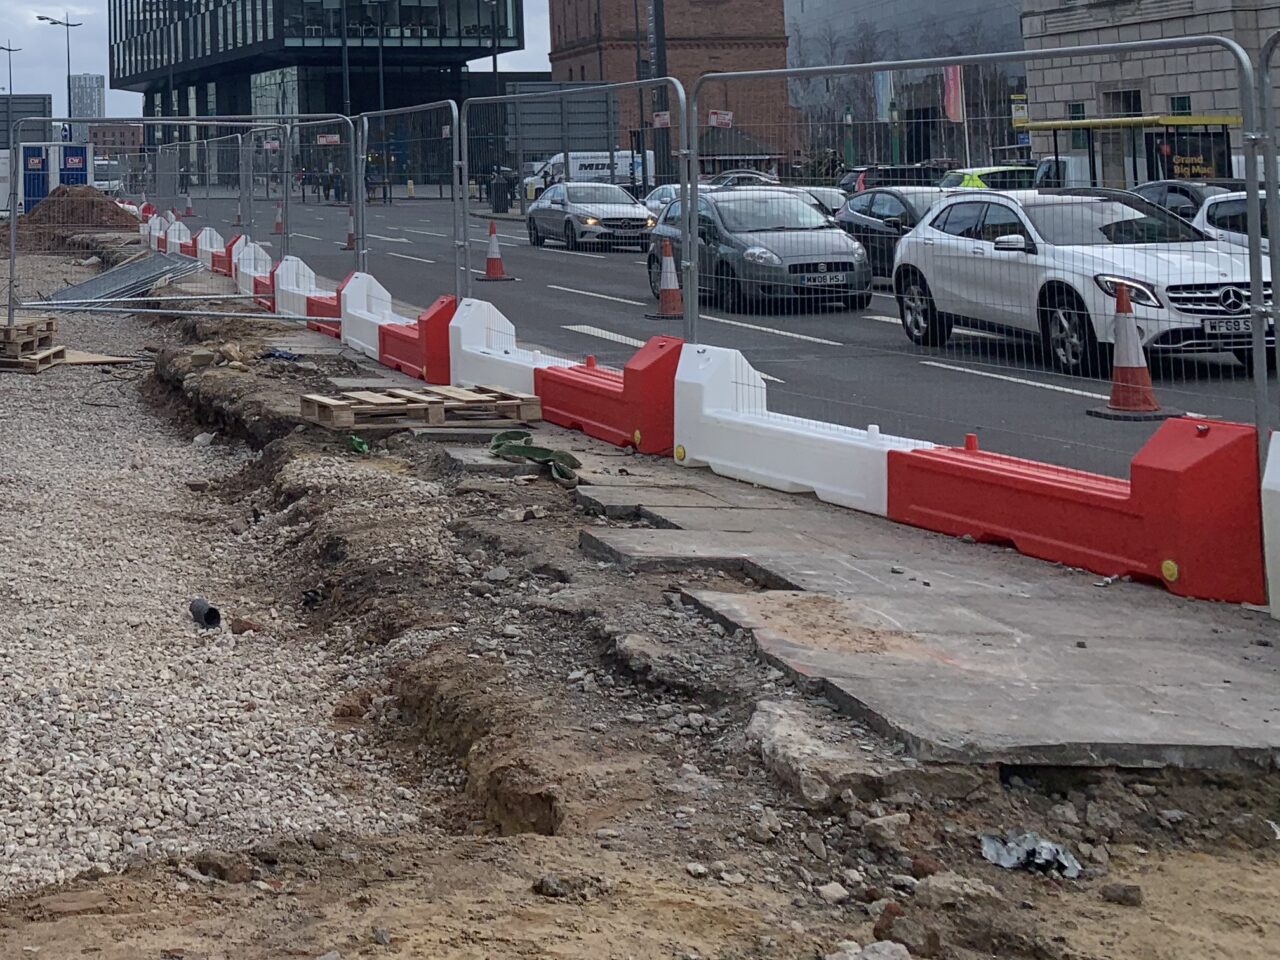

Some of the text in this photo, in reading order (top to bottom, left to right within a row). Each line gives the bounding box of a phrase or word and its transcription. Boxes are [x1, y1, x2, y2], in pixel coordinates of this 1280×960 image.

[1173, 155, 1204, 164] Grand
[1173, 165, 1213, 174] Big Mac
